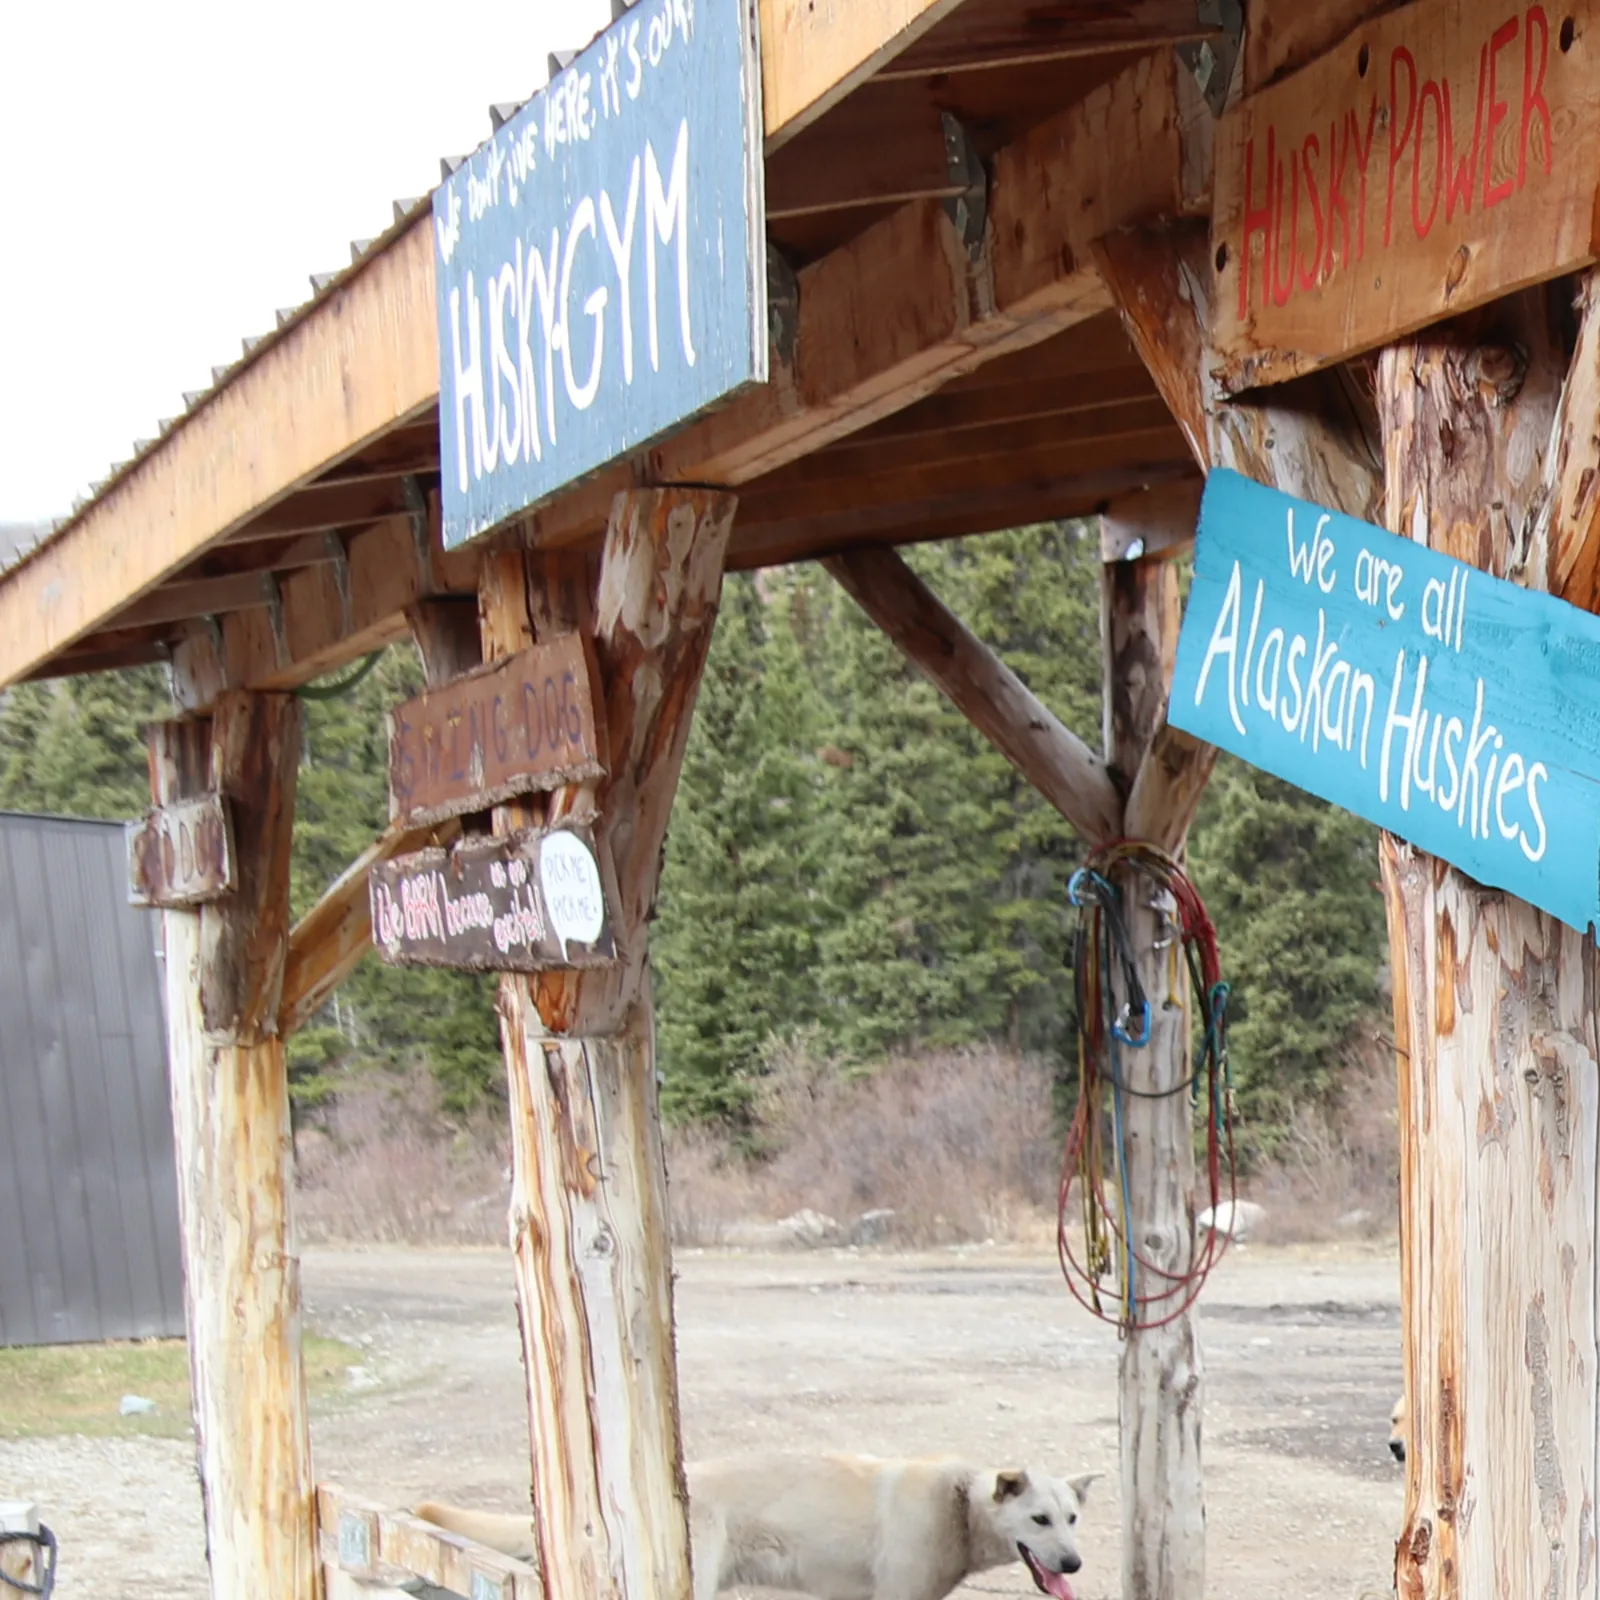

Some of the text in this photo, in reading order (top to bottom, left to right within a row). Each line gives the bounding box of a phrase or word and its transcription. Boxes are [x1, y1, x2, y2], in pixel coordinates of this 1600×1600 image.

[1238, 4, 1553, 320] HUSKY POWER
[1287, 508, 1468, 652] We are all
[523, 671, 582, 760] DOG
[1195, 560, 1548, 862] Alaskan Huskies
